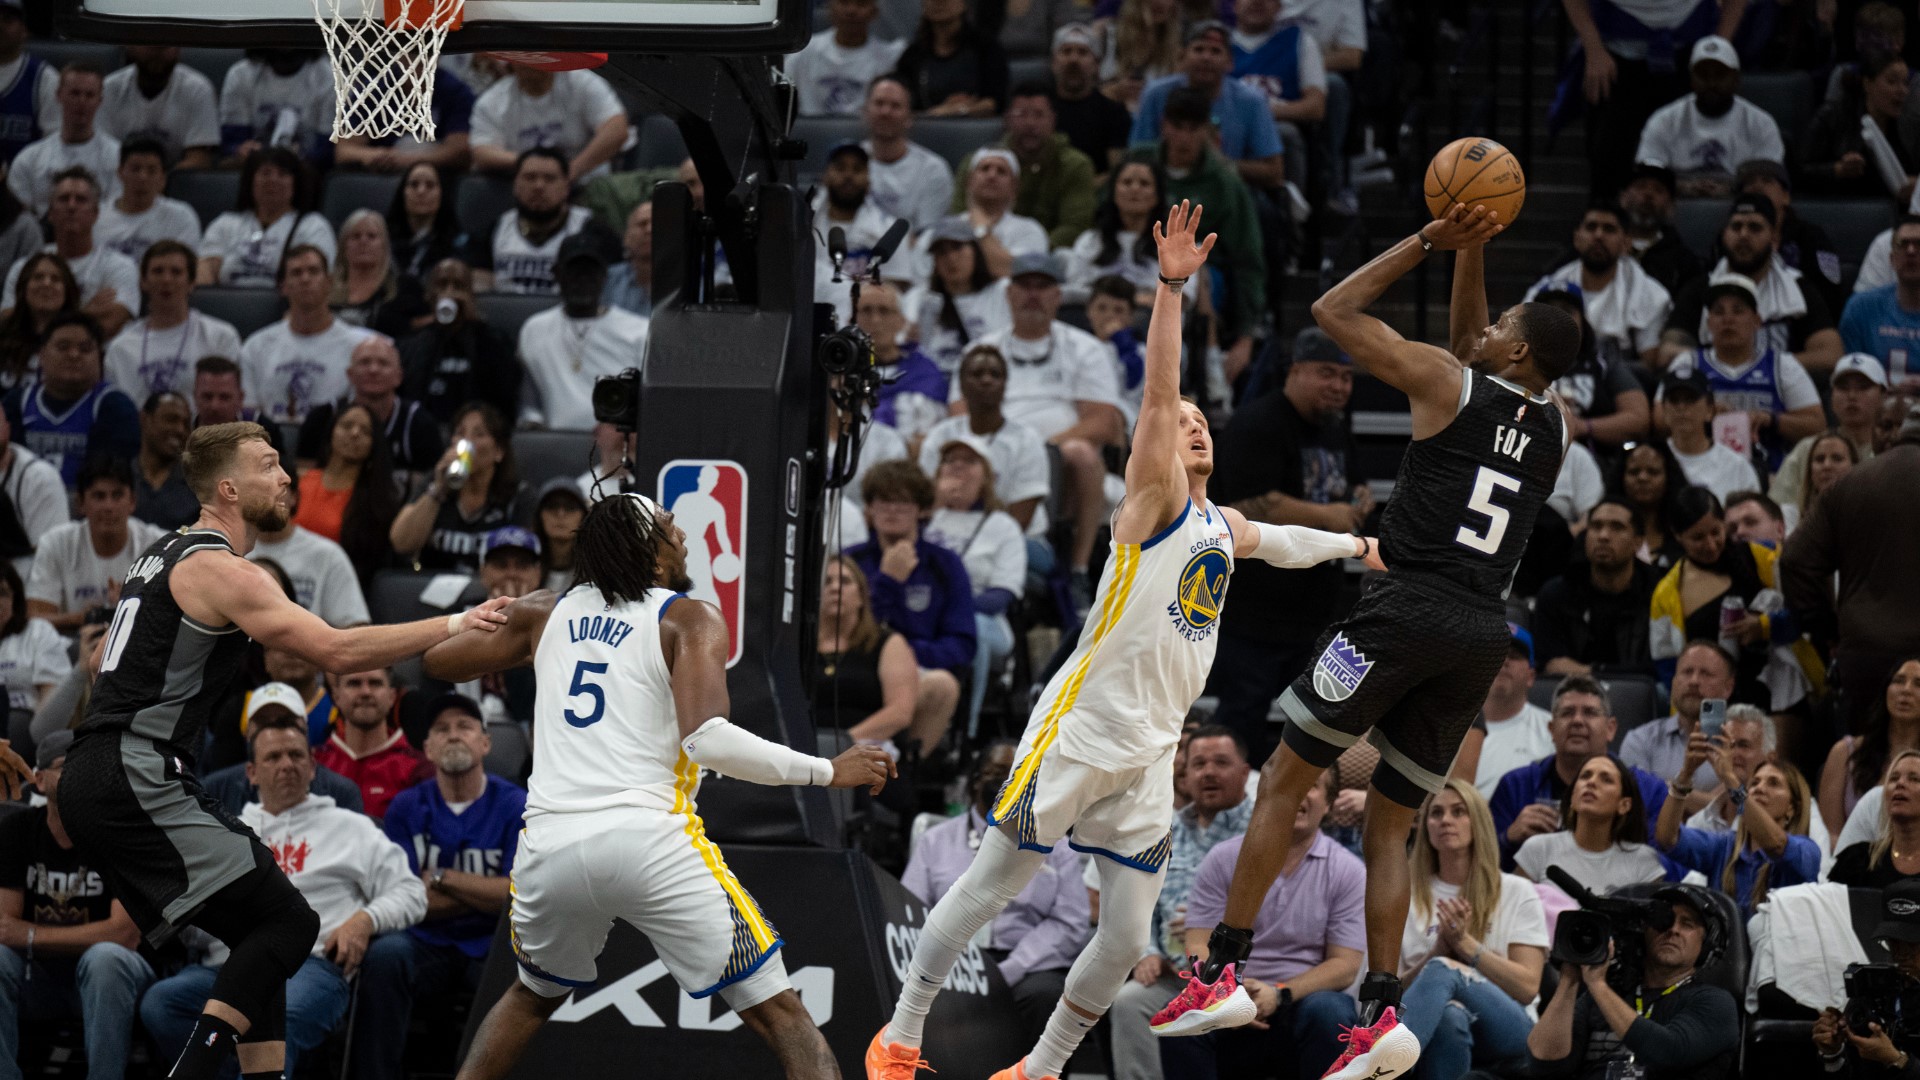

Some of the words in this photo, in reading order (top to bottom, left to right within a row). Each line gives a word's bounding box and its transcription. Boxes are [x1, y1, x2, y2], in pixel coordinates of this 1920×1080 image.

[1493, 424, 1532, 462] FOX
[1454, 465, 1522, 556] 5
[1212, 573, 1224, 595] 0
[568, 615, 634, 648] LOONEY
[1320, 651, 1358, 691] KINGS
[1328, 647, 1362, 679] SACRAMENTO
[564, 660, 609, 728] 5
